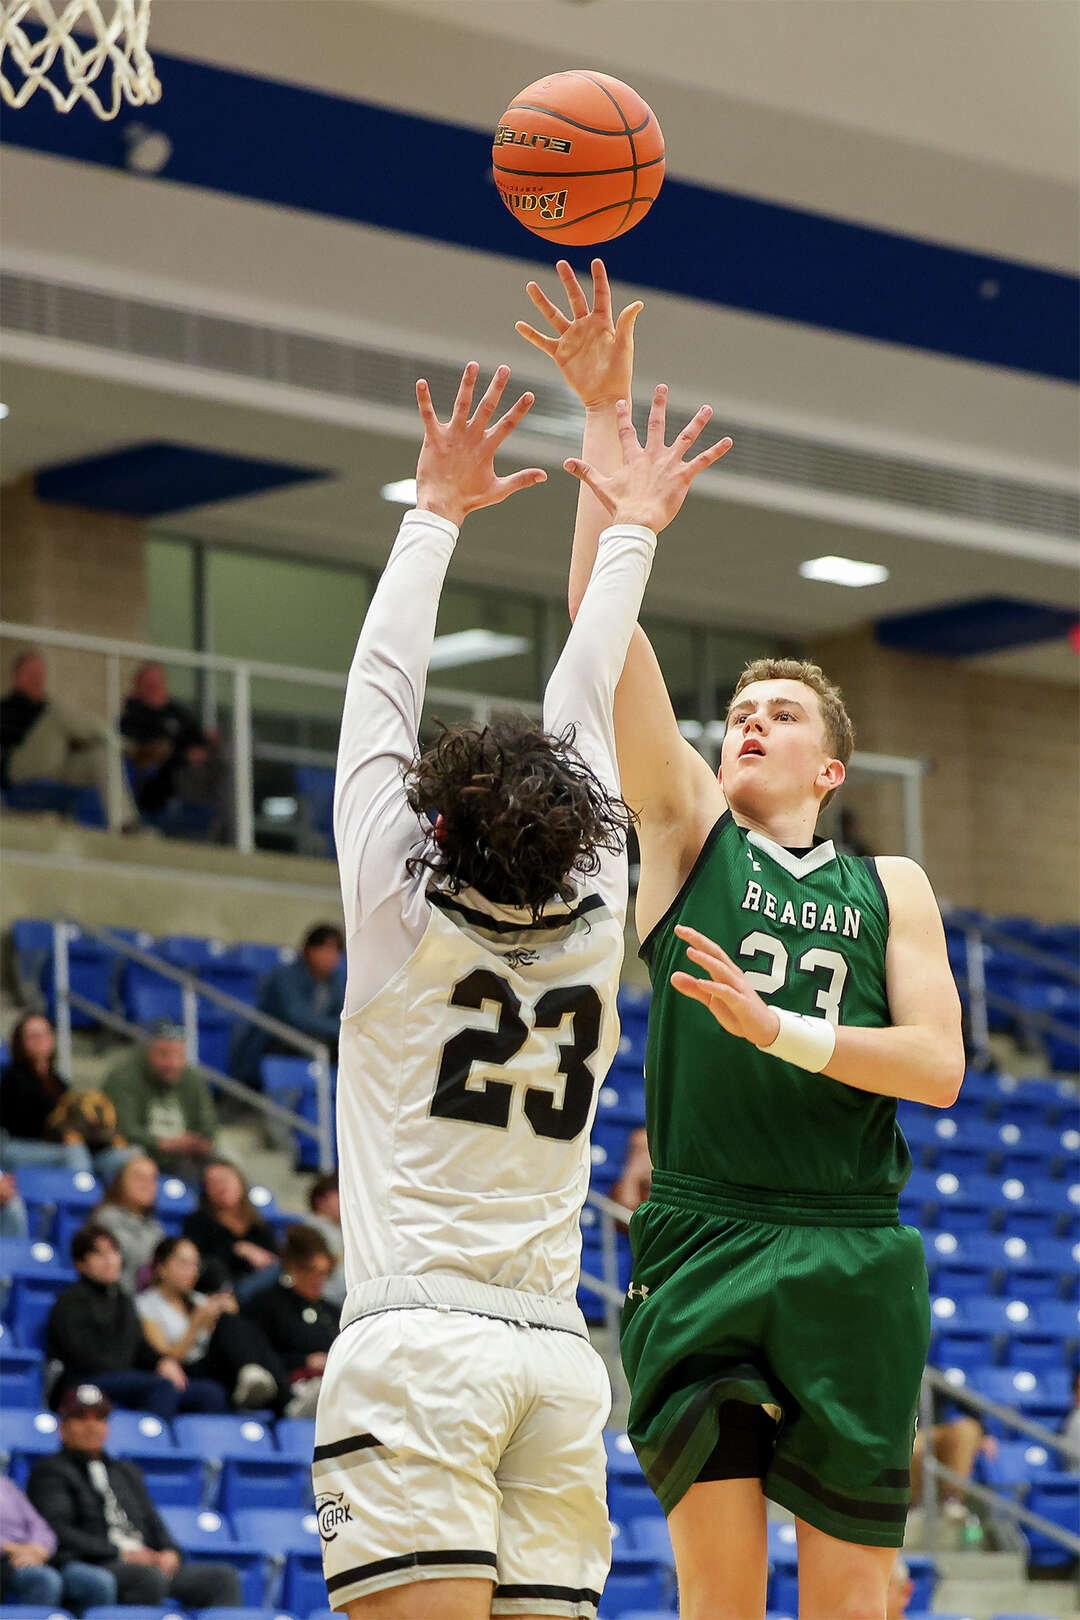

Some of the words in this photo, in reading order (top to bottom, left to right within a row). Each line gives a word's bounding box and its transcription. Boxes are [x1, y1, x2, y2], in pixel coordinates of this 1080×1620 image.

[503, 129, 573, 155] ELITE
[499, 189, 568, 220] Bad
[741, 879, 862, 940] REAGAN
[427, 968, 605, 1143] 23
[316, 1500, 353, 1542] CLARK
